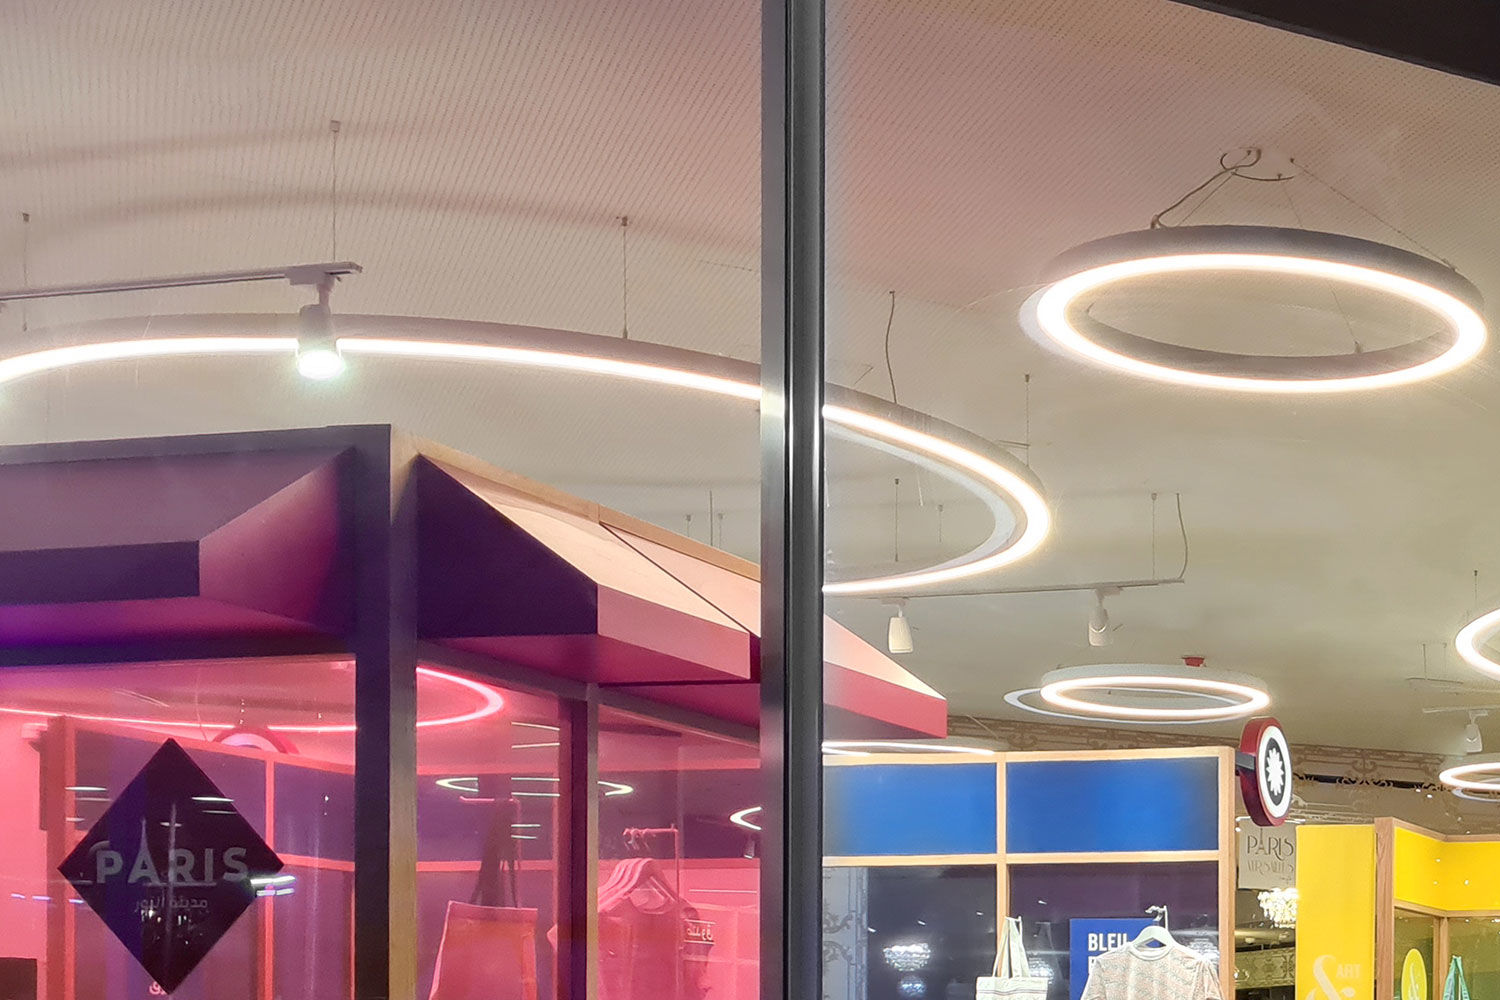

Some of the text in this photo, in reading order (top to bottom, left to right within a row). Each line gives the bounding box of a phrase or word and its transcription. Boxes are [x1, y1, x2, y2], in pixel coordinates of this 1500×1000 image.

[96, 820, 249, 885] PARIS
[1247, 828, 1294, 861] PARIS
[1088, 932, 1128, 952] BLEU
[1336, 964, 1361, 979] ART
